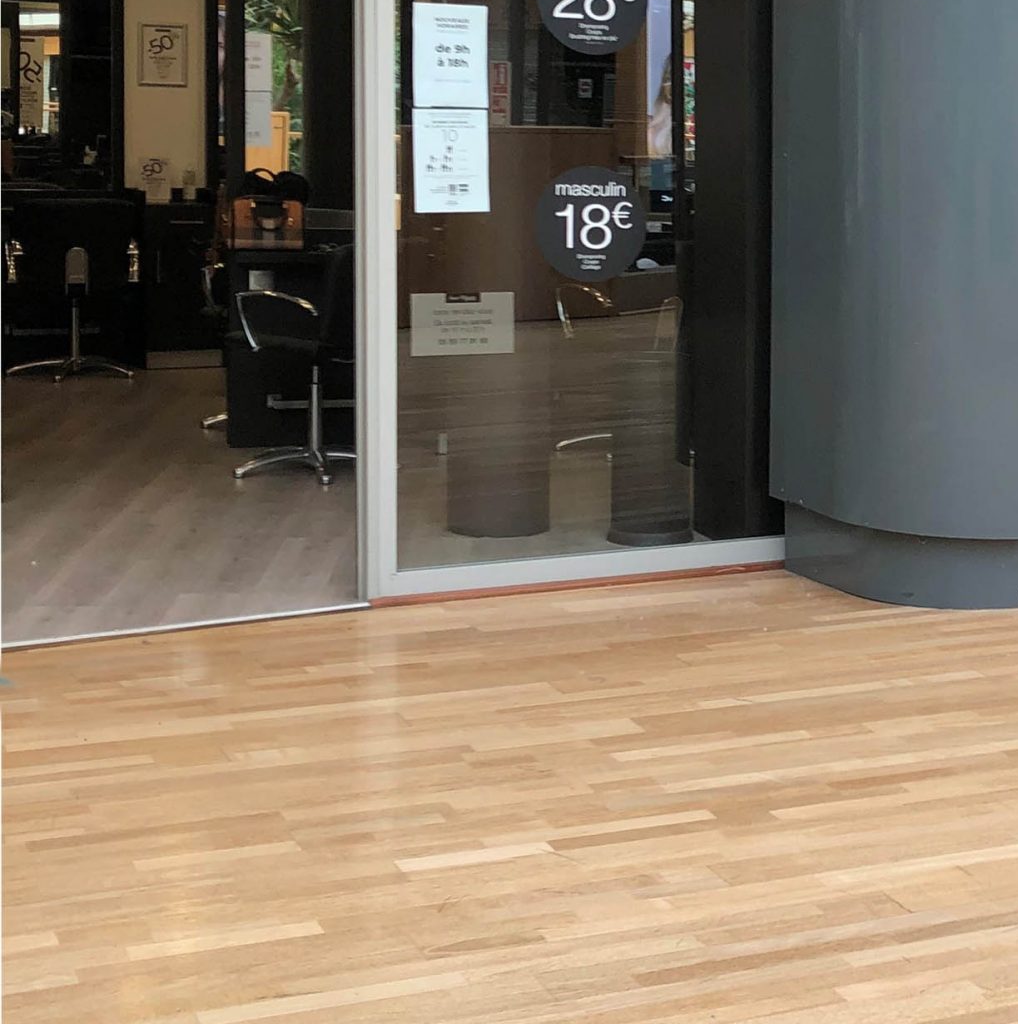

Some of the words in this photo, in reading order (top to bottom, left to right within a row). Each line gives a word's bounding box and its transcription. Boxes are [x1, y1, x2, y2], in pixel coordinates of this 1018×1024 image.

[435, 43, 452, 54] de
[554, 181, 627, 197] masculin
[554, 201, 634, 250] 18€
